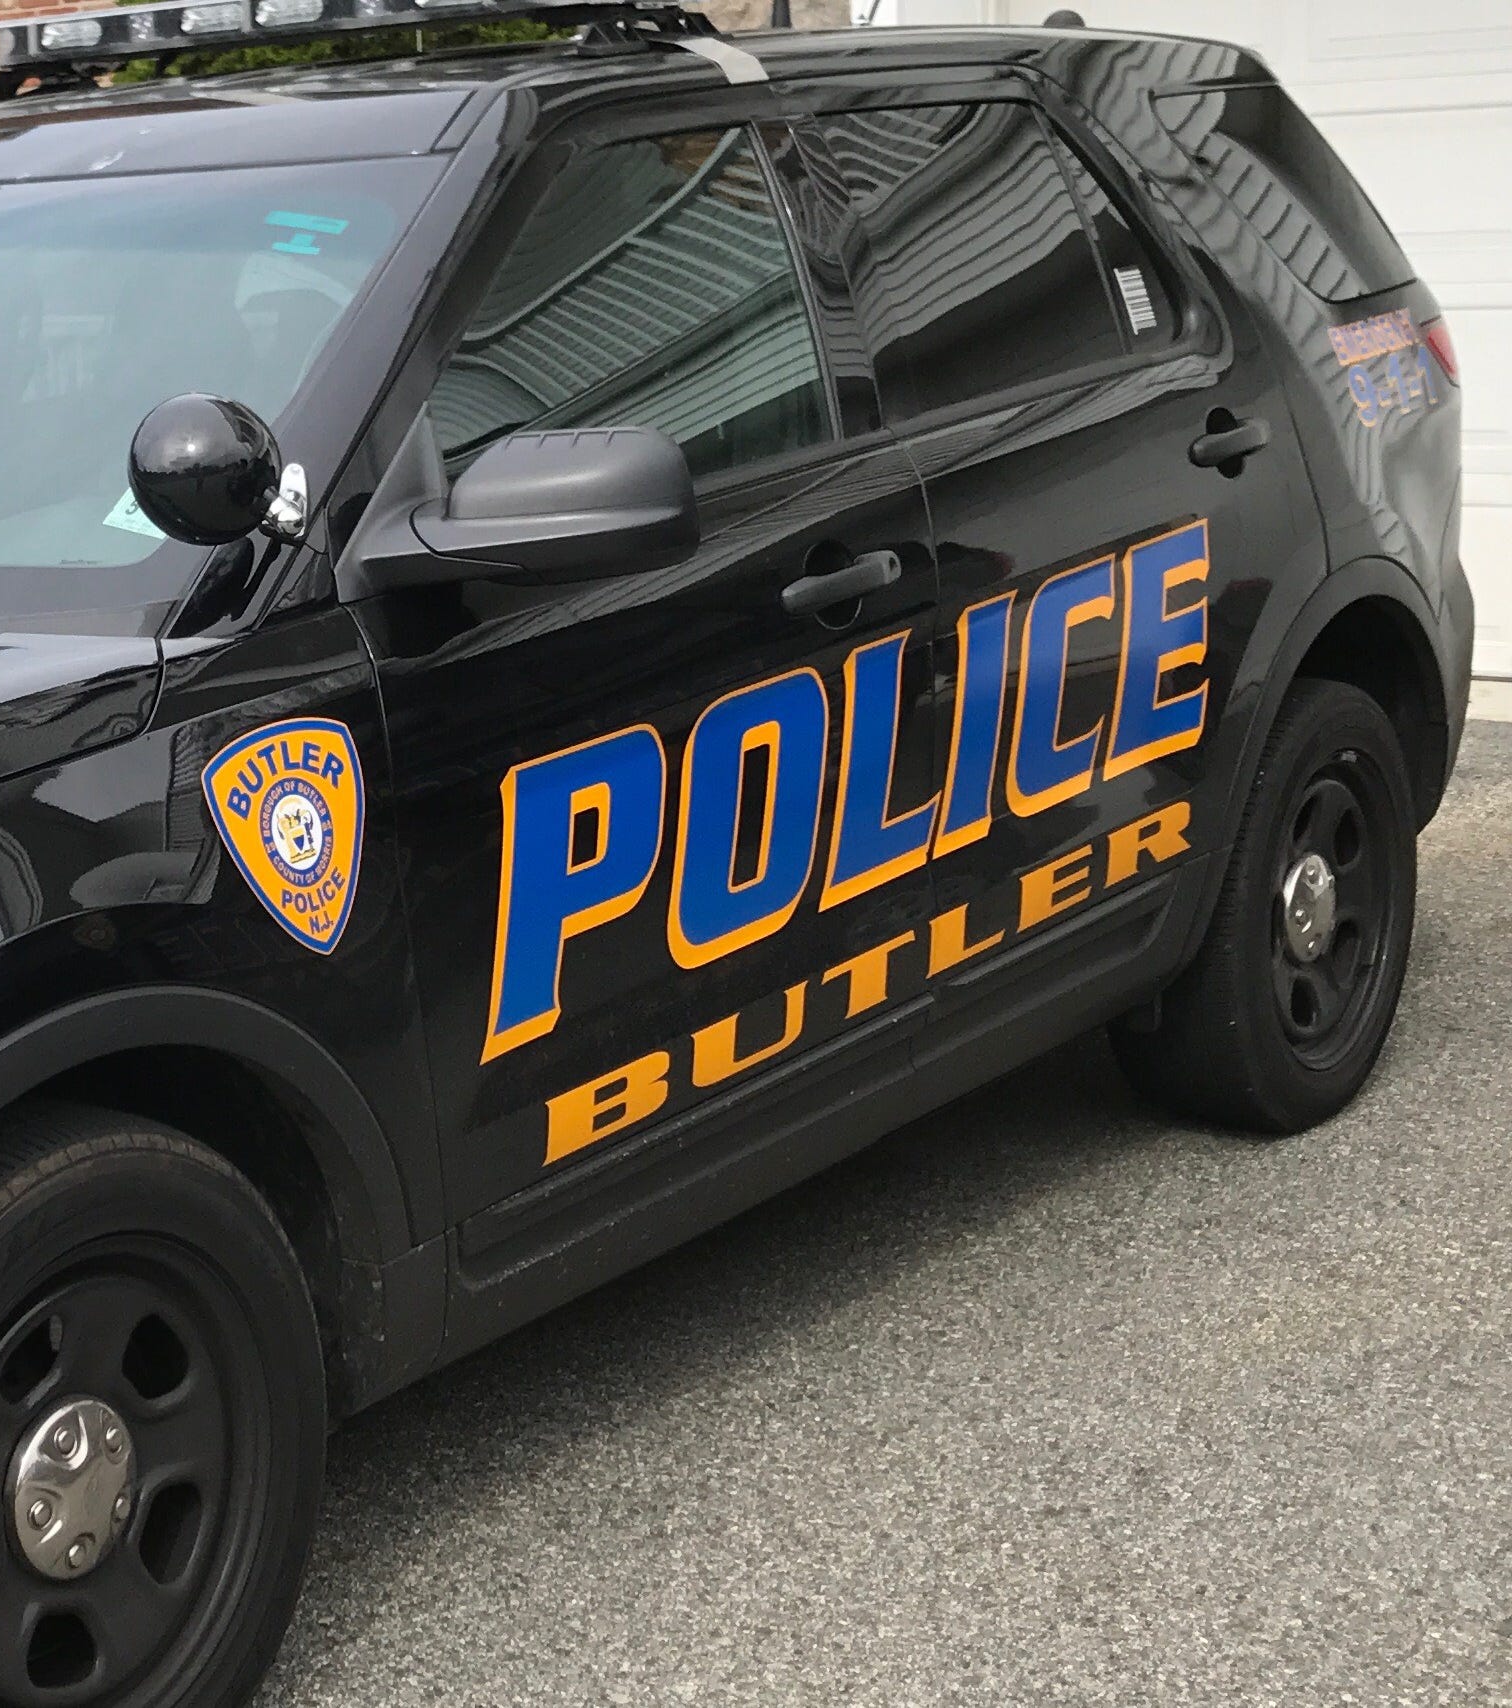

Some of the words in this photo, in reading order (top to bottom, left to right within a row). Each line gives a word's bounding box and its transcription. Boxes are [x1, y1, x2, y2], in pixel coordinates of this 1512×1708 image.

[227, 741, 345, 820] BUTLER
[281, 866, 346, 913] POLICE
[480, 518, 1210, 1065] POLICE
[542, 801, 1193, 1167] BUTLER
